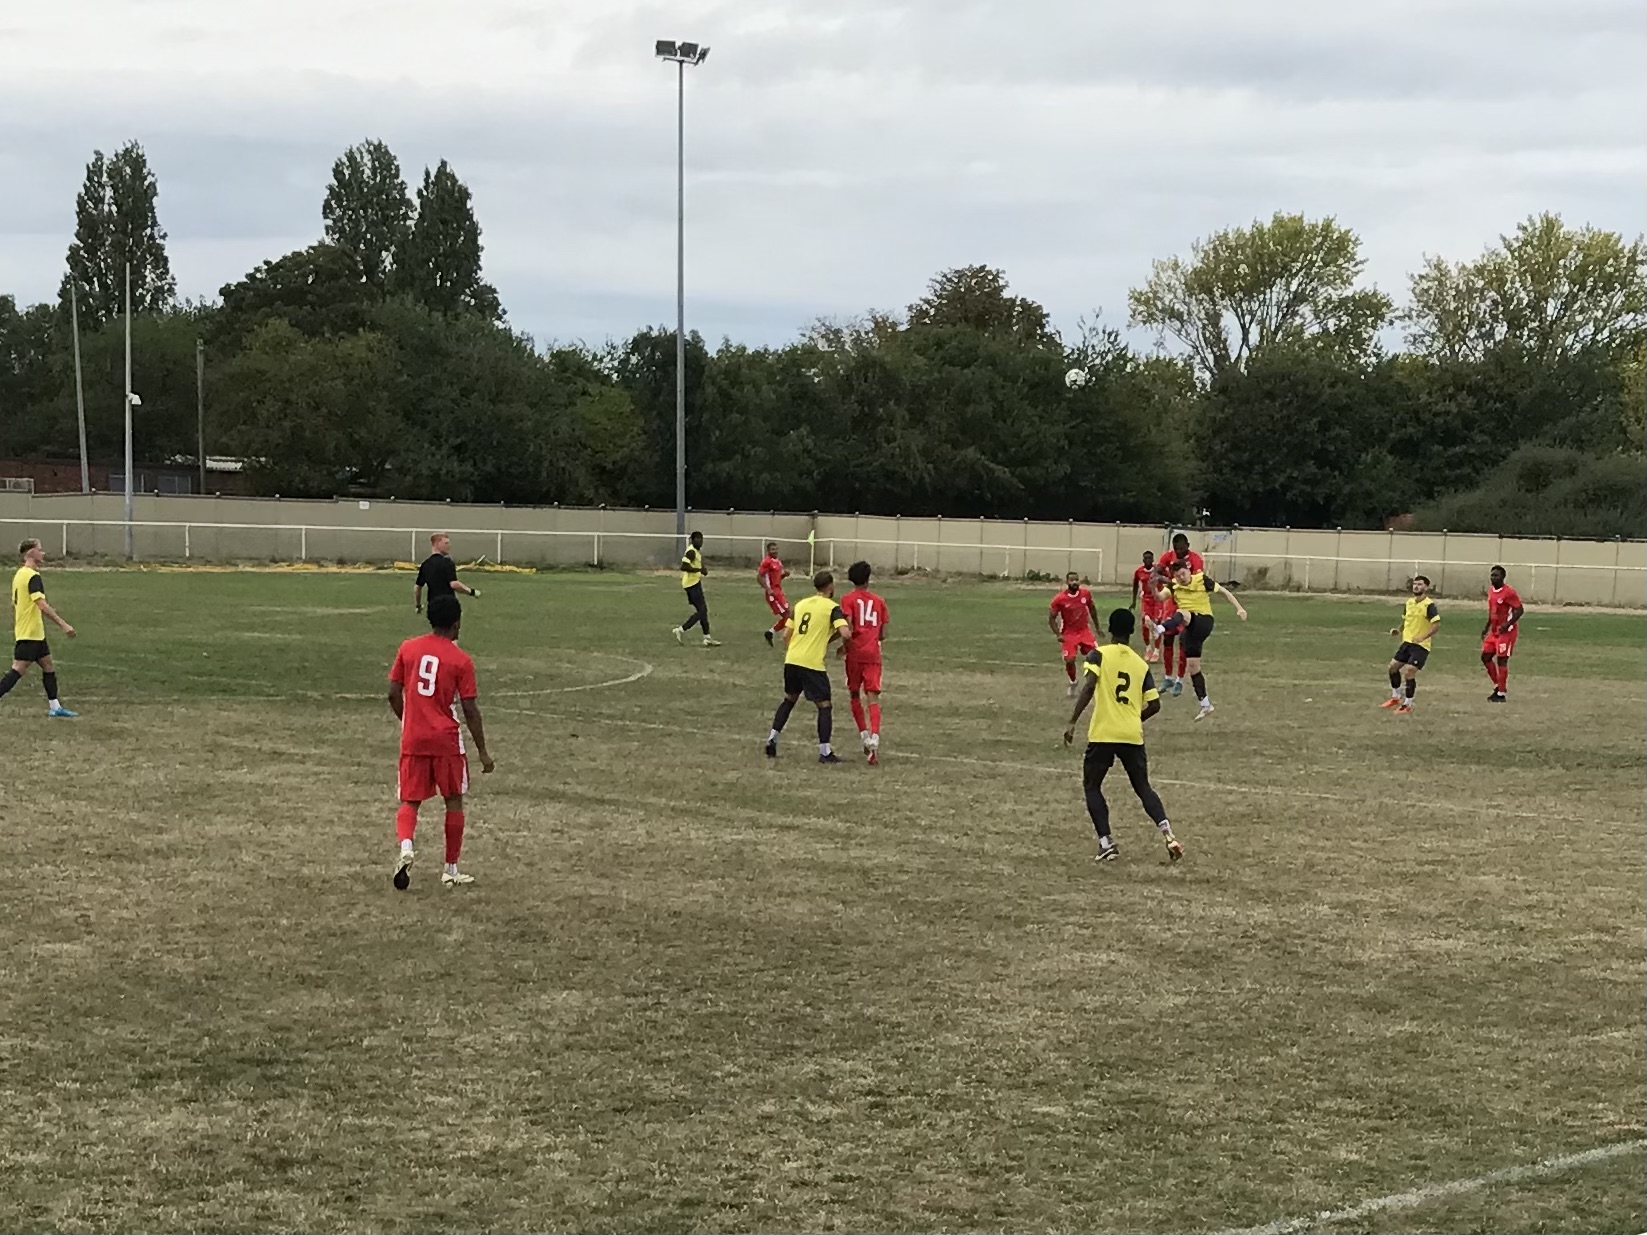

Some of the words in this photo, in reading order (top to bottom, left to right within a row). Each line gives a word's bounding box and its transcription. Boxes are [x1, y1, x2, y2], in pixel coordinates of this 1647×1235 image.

[799, 612, 812, 634] 8
[857, 598, 878, 627] 14
[417, 655, 439, 696] 9
[1115, 671, 1131, 705] 2
